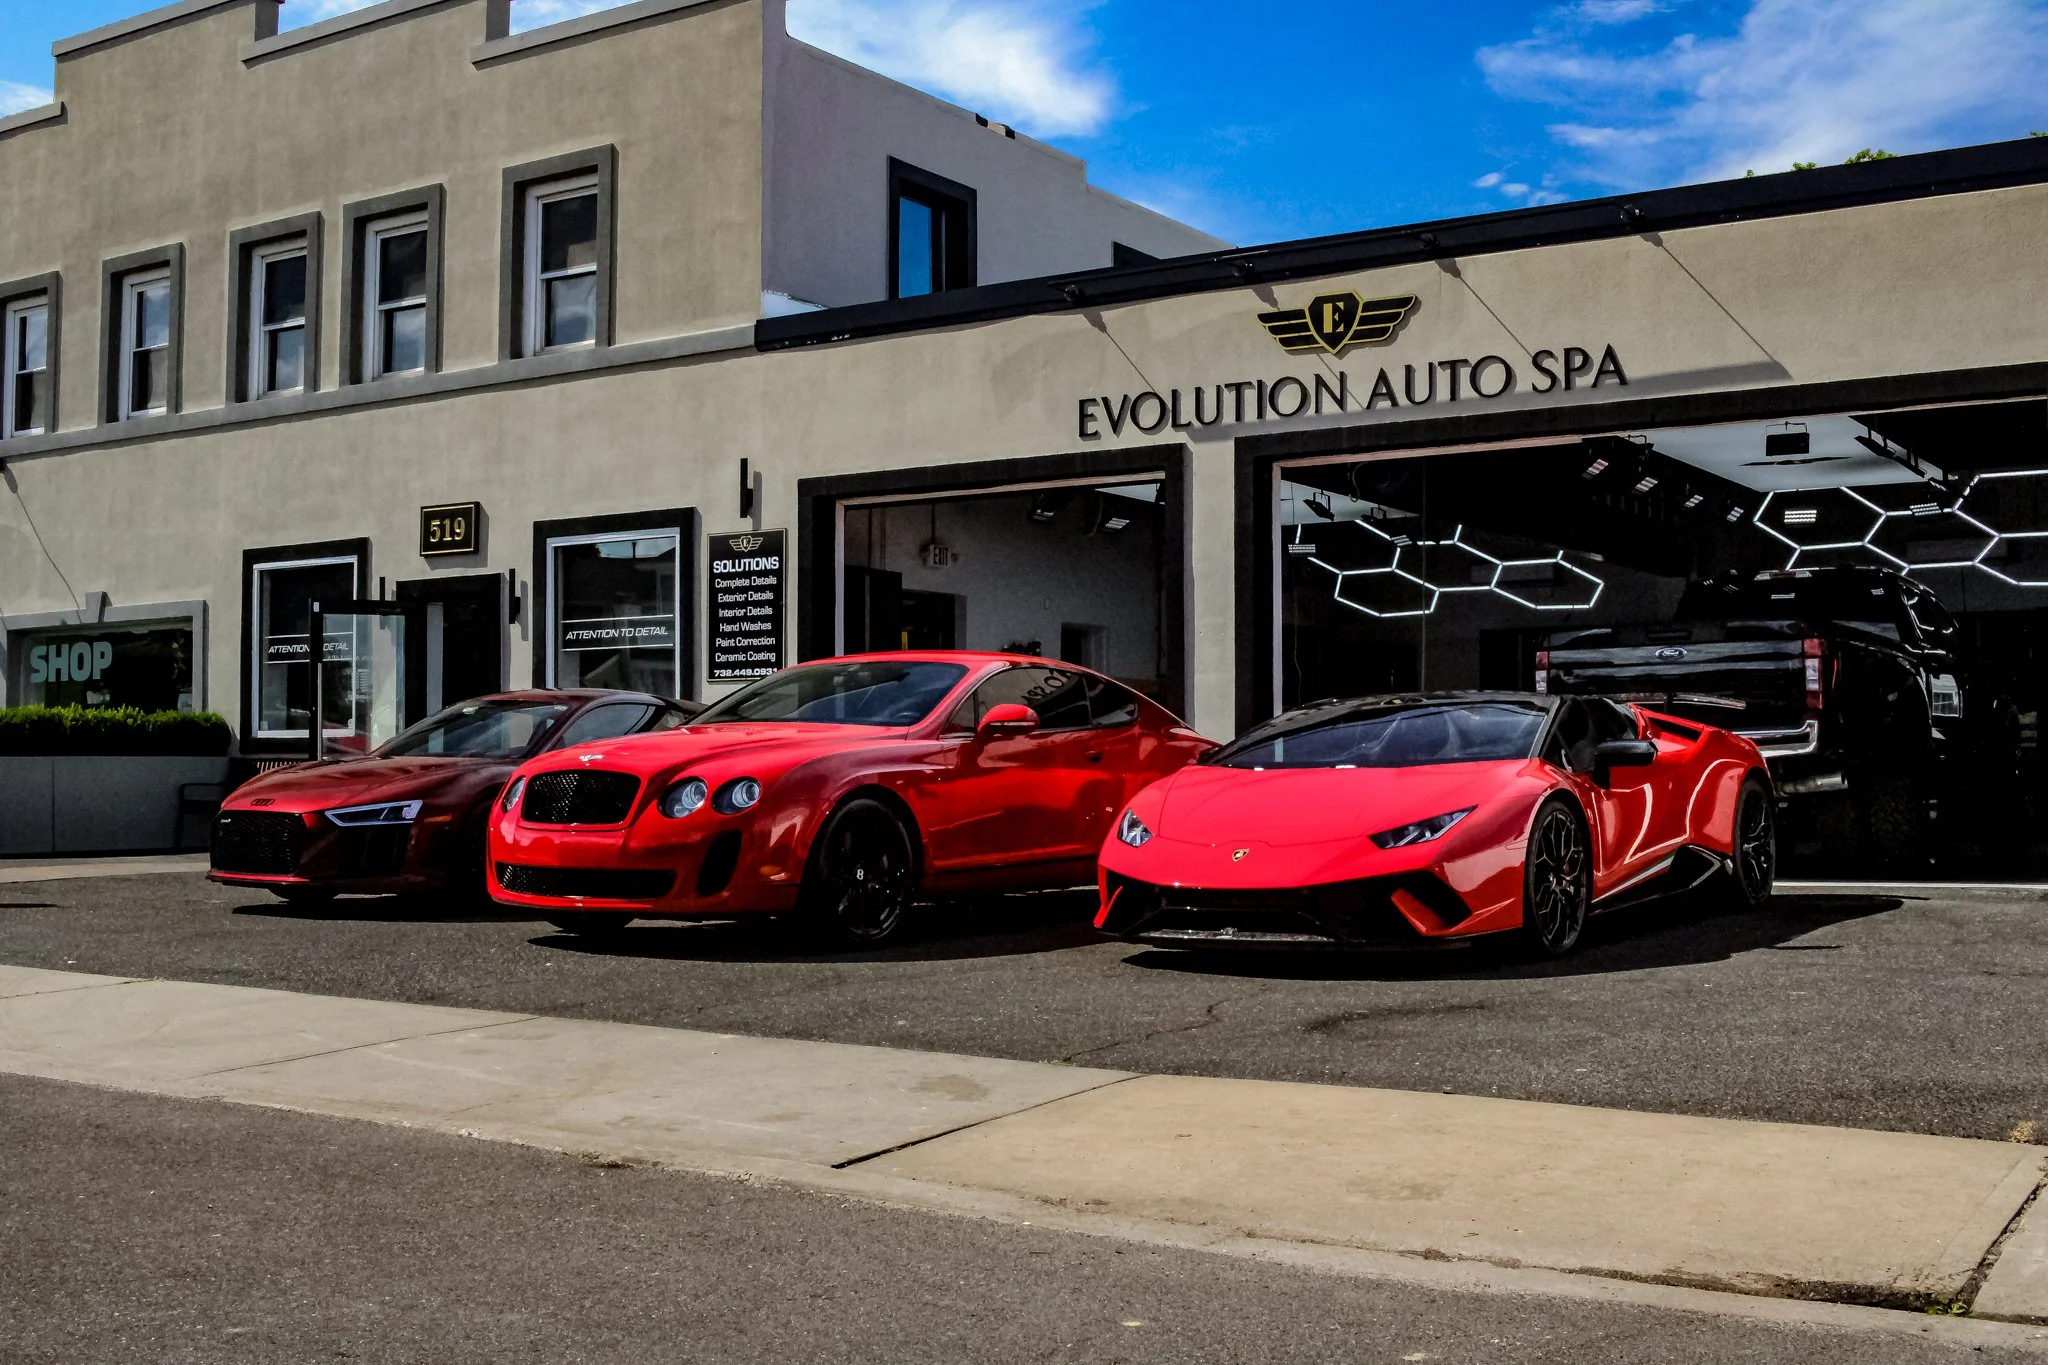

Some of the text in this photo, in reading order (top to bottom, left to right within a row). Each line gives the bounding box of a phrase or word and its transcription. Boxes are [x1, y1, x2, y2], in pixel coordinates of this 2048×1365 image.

[1323, 302, 1344, 333] E
[1078, 343, 1629, 437] EVOLUTION AUTO SPA
[430, 517, 465, 542] 519
[933, 546, 949, 566] EXIT
[713, 556, 779, 573] SOLUTIONS
[715, 575, 777, 589] Complete Details
[718, 590, 774, 602] Exterior Details
[718, 605, 773, 617] Interior Details
[719, 621, 772, 632] Hand Washes
[565, 627, 669, 640] ATTENTION TO DETAIL
[322, 642, 349, 651] DETAIL
[715, 635, 776, 647] Paint Correction
[268, 644, 310, 654] ATTENTION
[30, 641, 113, 683] SHOP
[715, 650, 776, 662] Ceramic Coating
